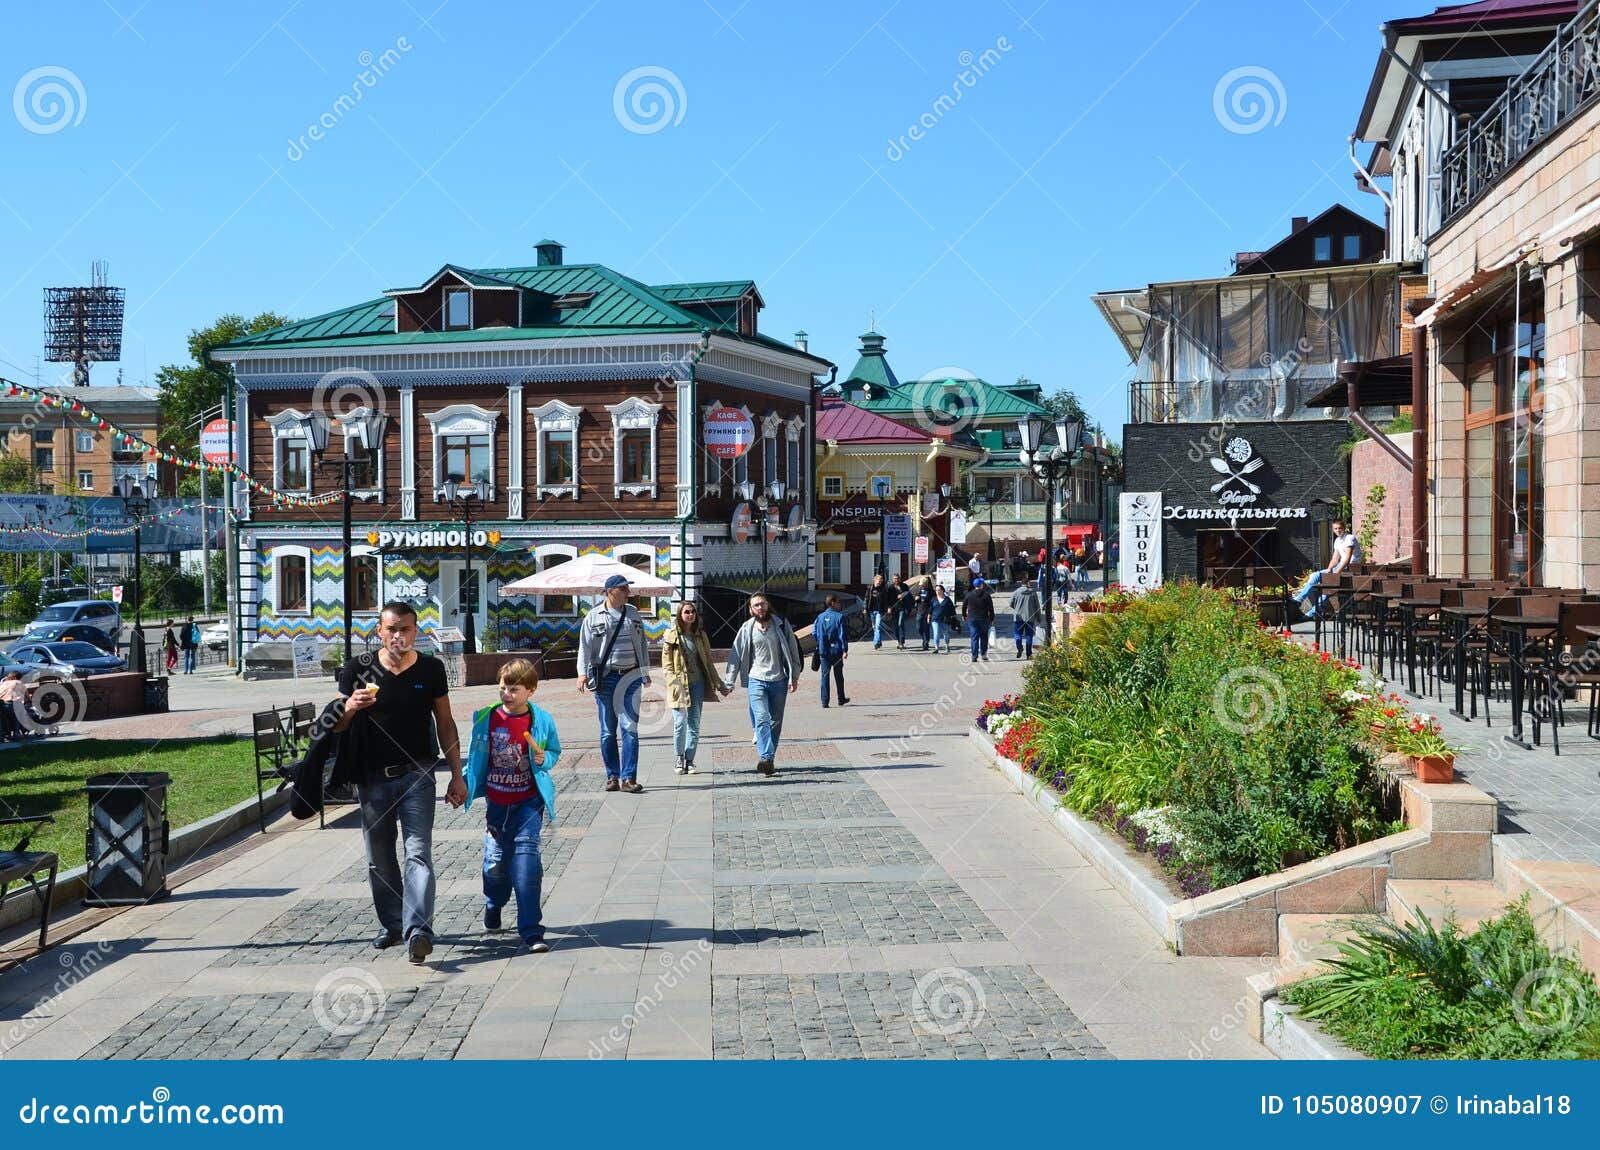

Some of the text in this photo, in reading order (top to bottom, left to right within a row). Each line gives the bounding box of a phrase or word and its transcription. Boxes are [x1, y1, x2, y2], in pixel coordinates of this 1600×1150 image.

[717, 447, 736, 455] CAFE
[1162, 505, 1308, 520] Хинкальная
[380, 530, 488, 548] РУМЯНОВО
[391, 584, 428, 598] КАФЕ
